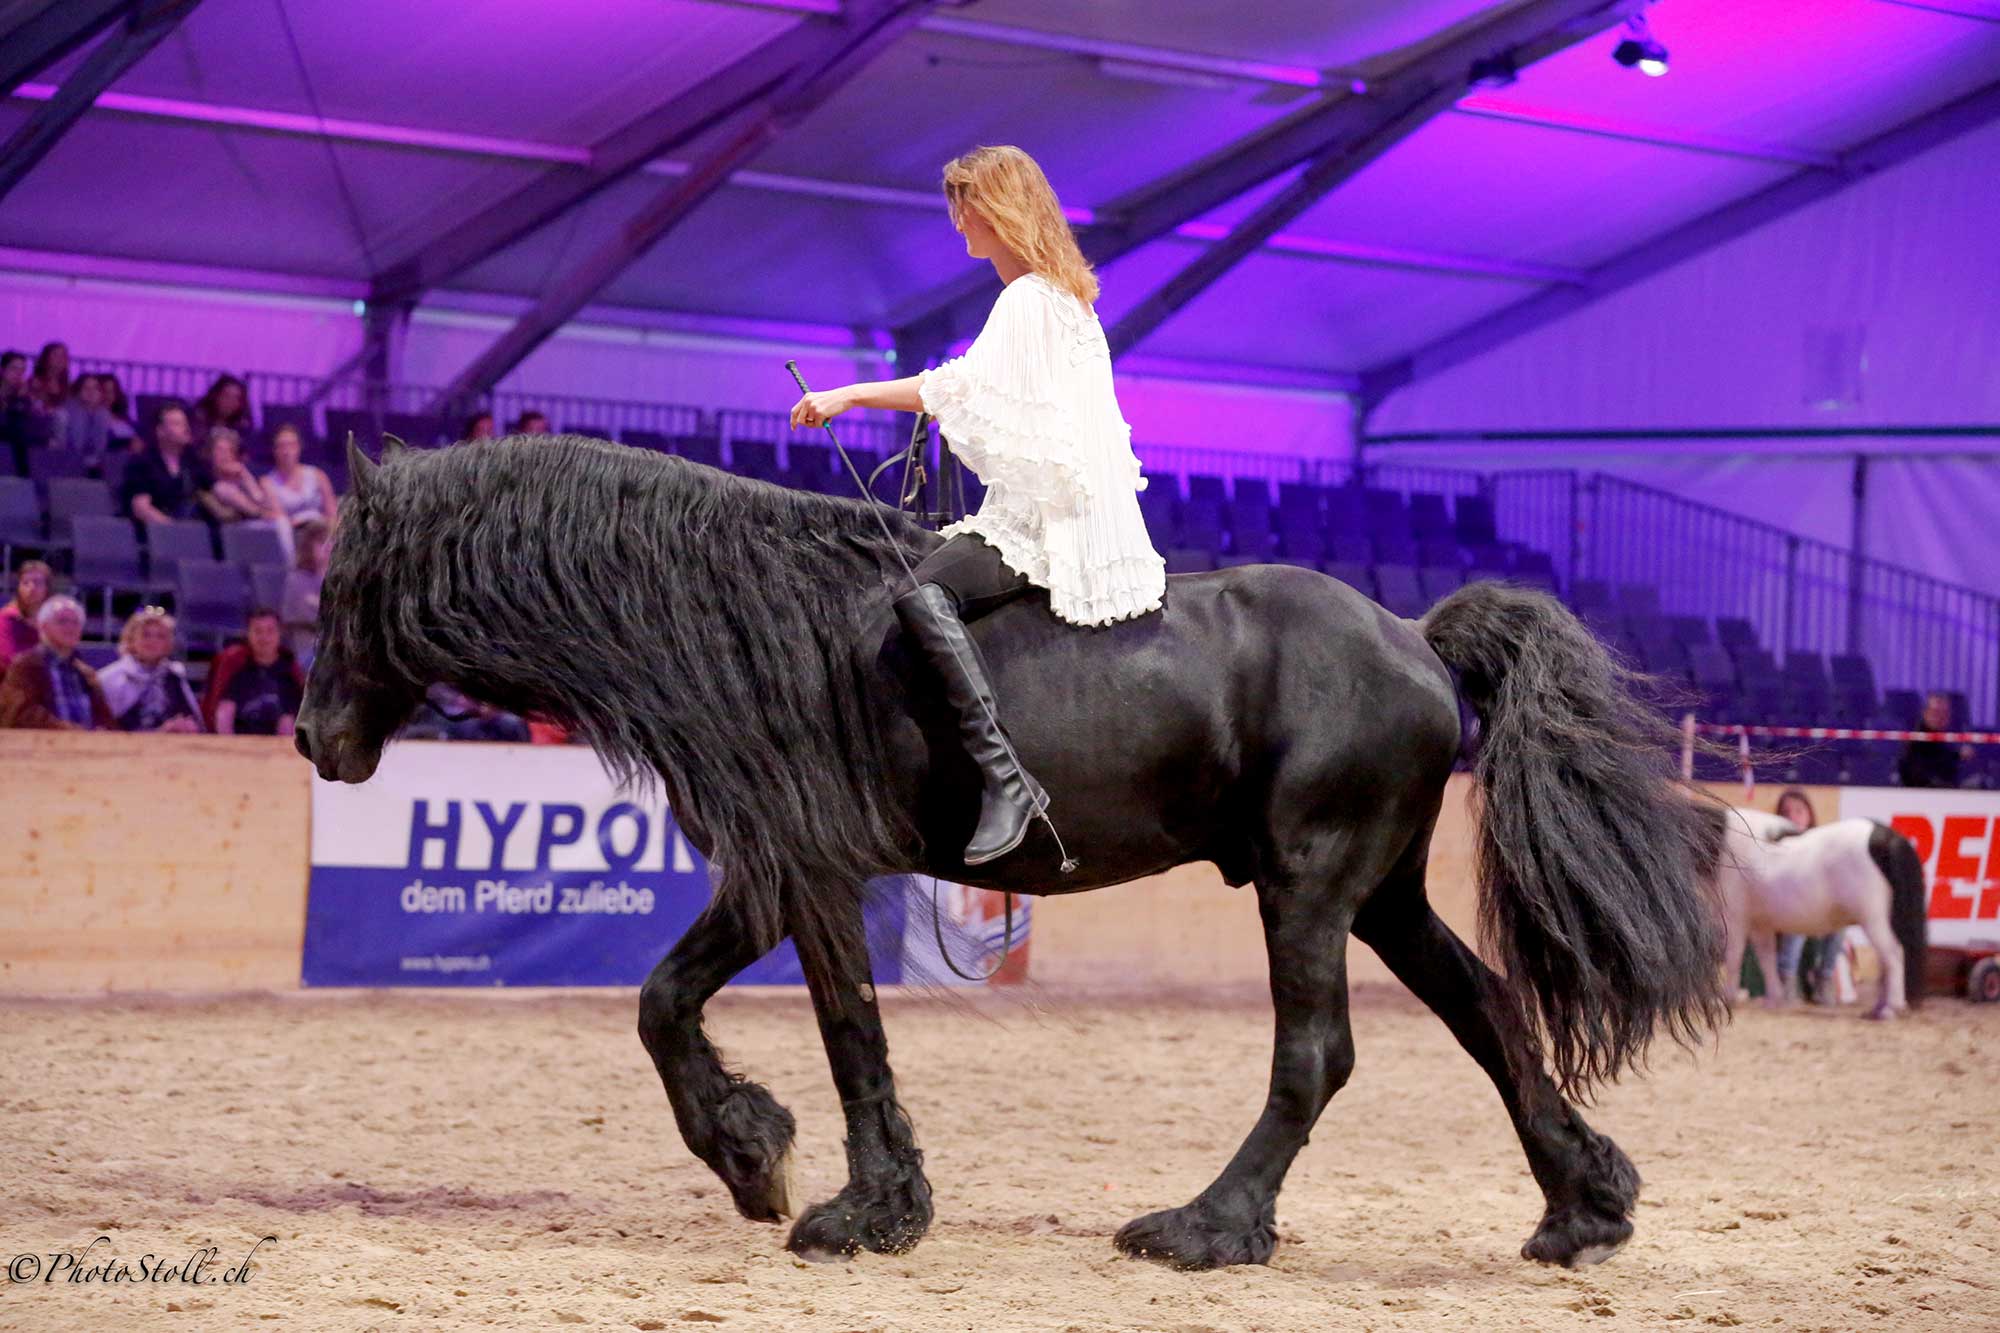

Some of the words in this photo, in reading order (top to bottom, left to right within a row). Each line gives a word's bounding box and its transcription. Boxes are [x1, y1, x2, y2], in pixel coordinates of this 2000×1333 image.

[401, 879, 466, 913] dem
[474, 880, 554, 914] Pferd
[558, 881, 655, 915] zuliebe
